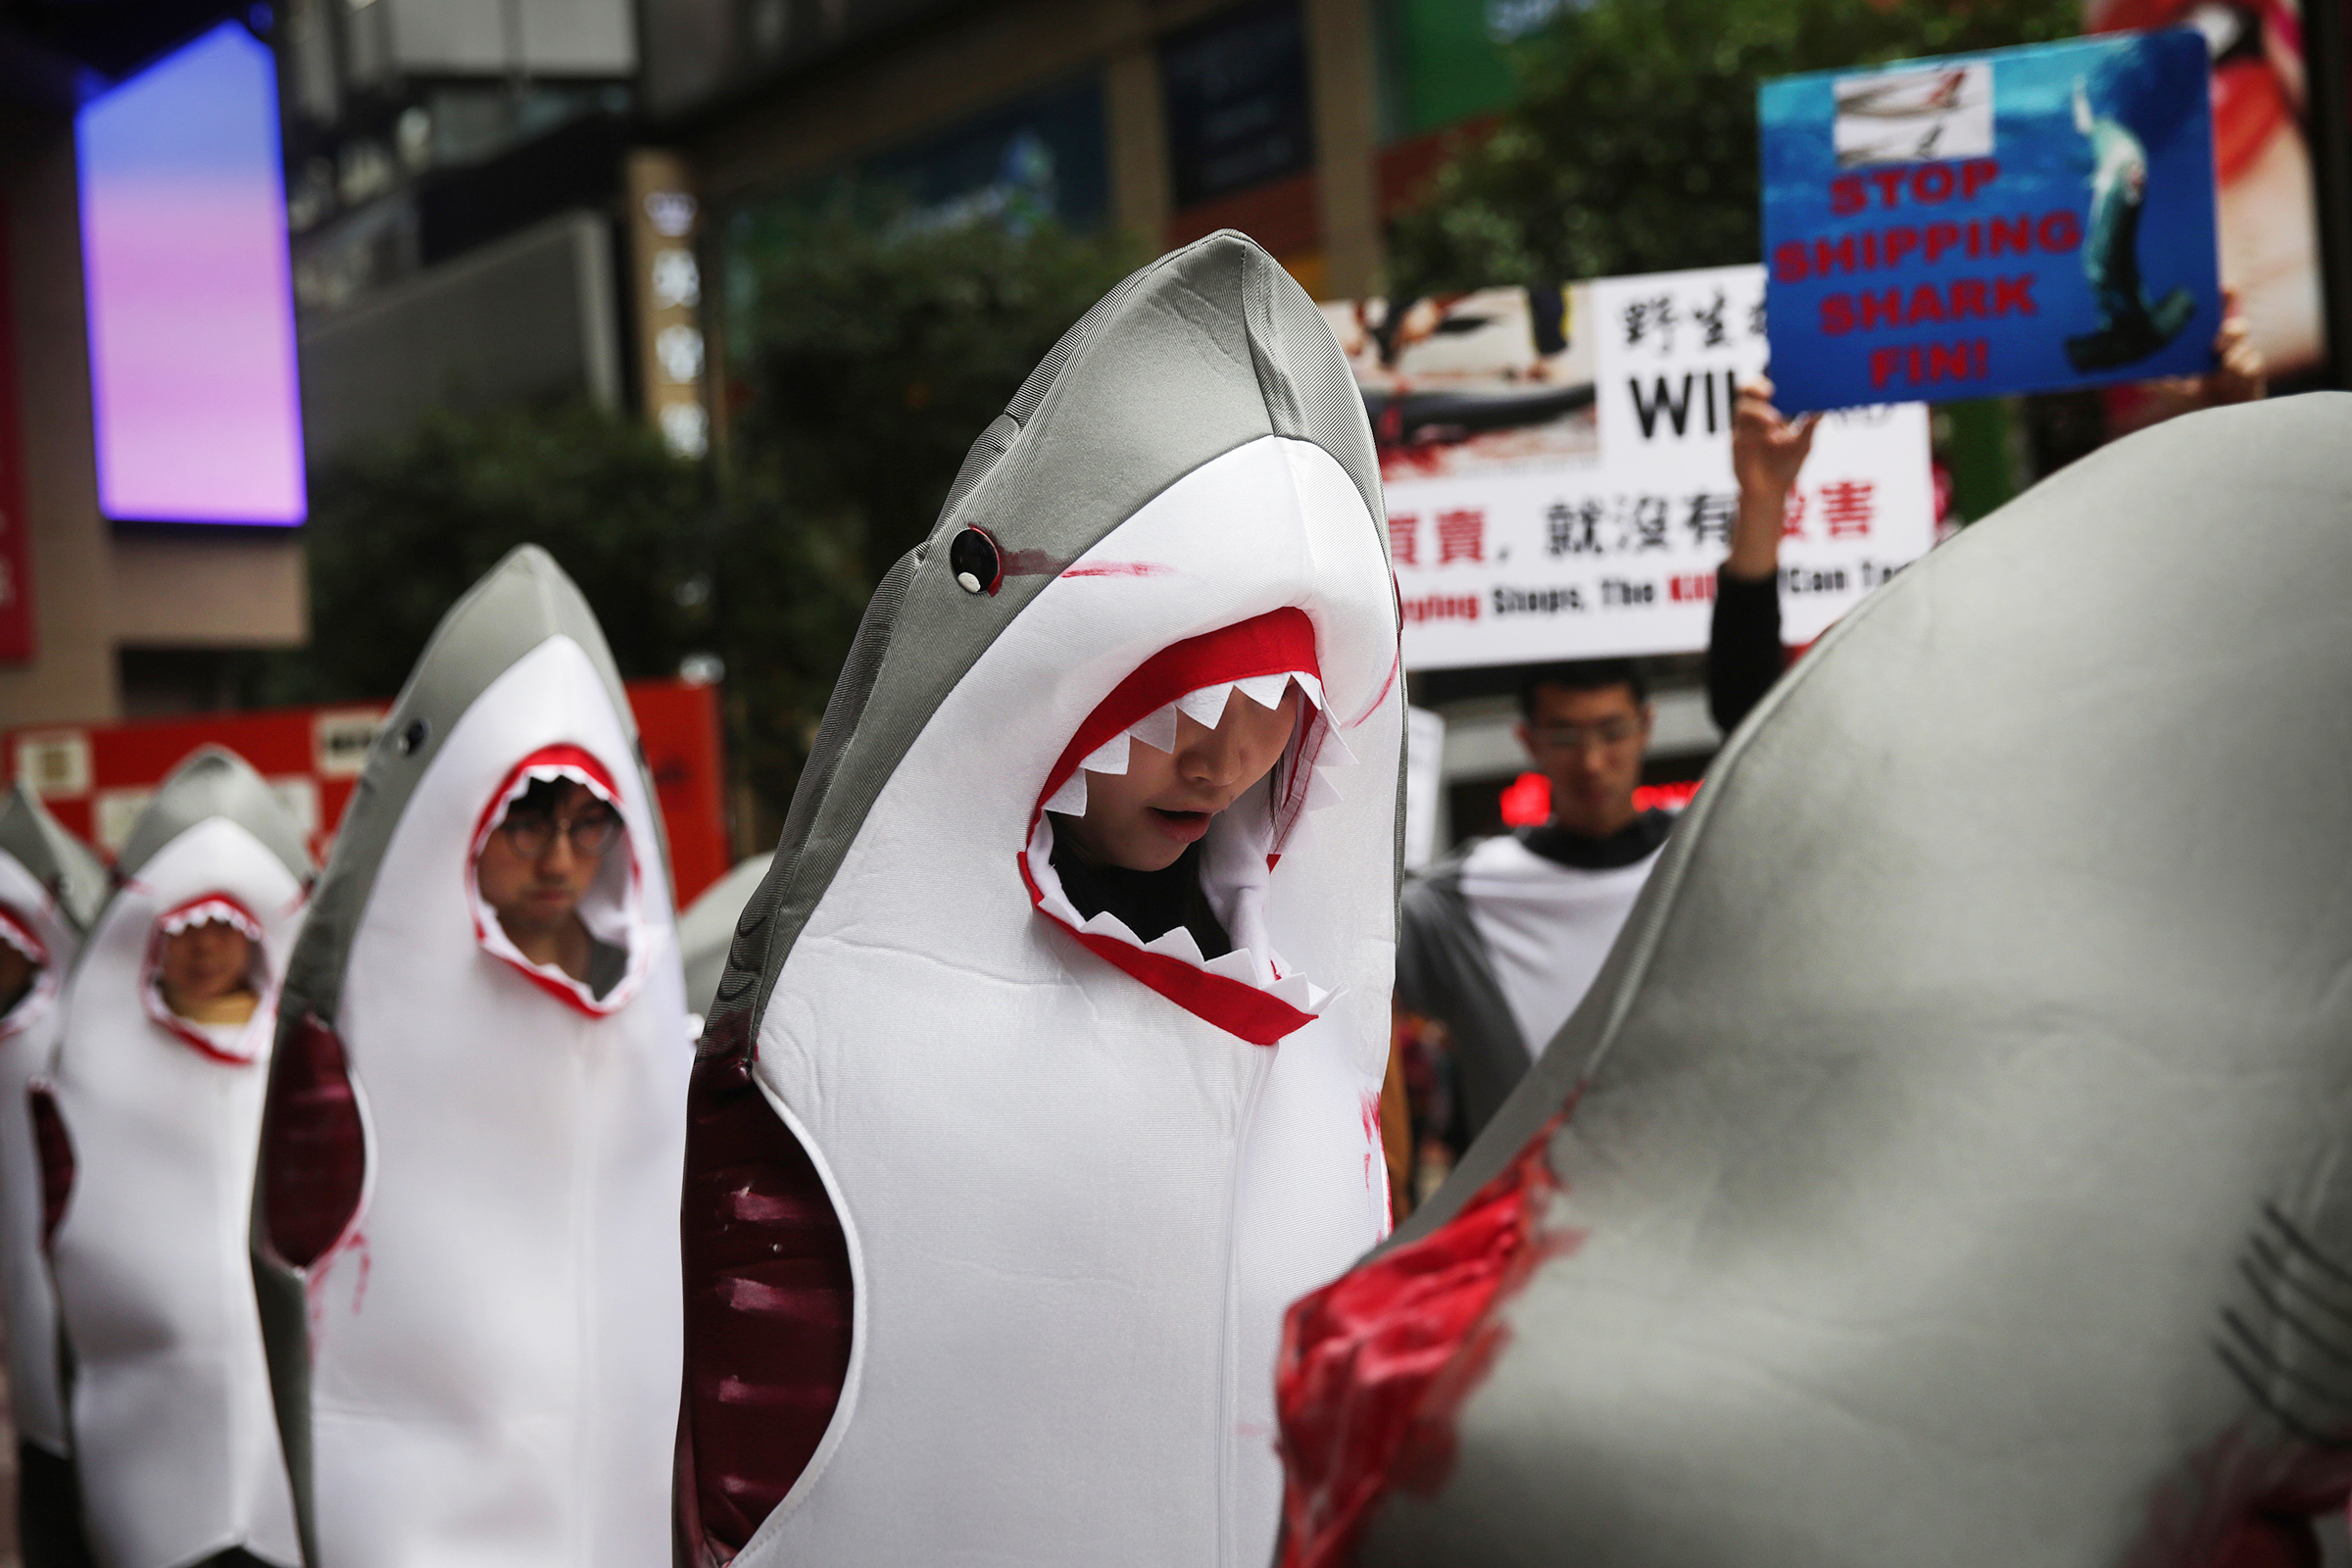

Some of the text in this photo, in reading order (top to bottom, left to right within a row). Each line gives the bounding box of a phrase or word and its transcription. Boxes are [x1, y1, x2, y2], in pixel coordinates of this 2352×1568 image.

[1831, 159, 1998, 216] STOP
[1774, 210, 2082, 283] SHIPPING
[1819, 273, 2036, 336] SHARK
[1870, 339, 1990, 389] FIN!
[1600, 576, 1655, 606] The
[1788, 565, 1848, 594] Can
